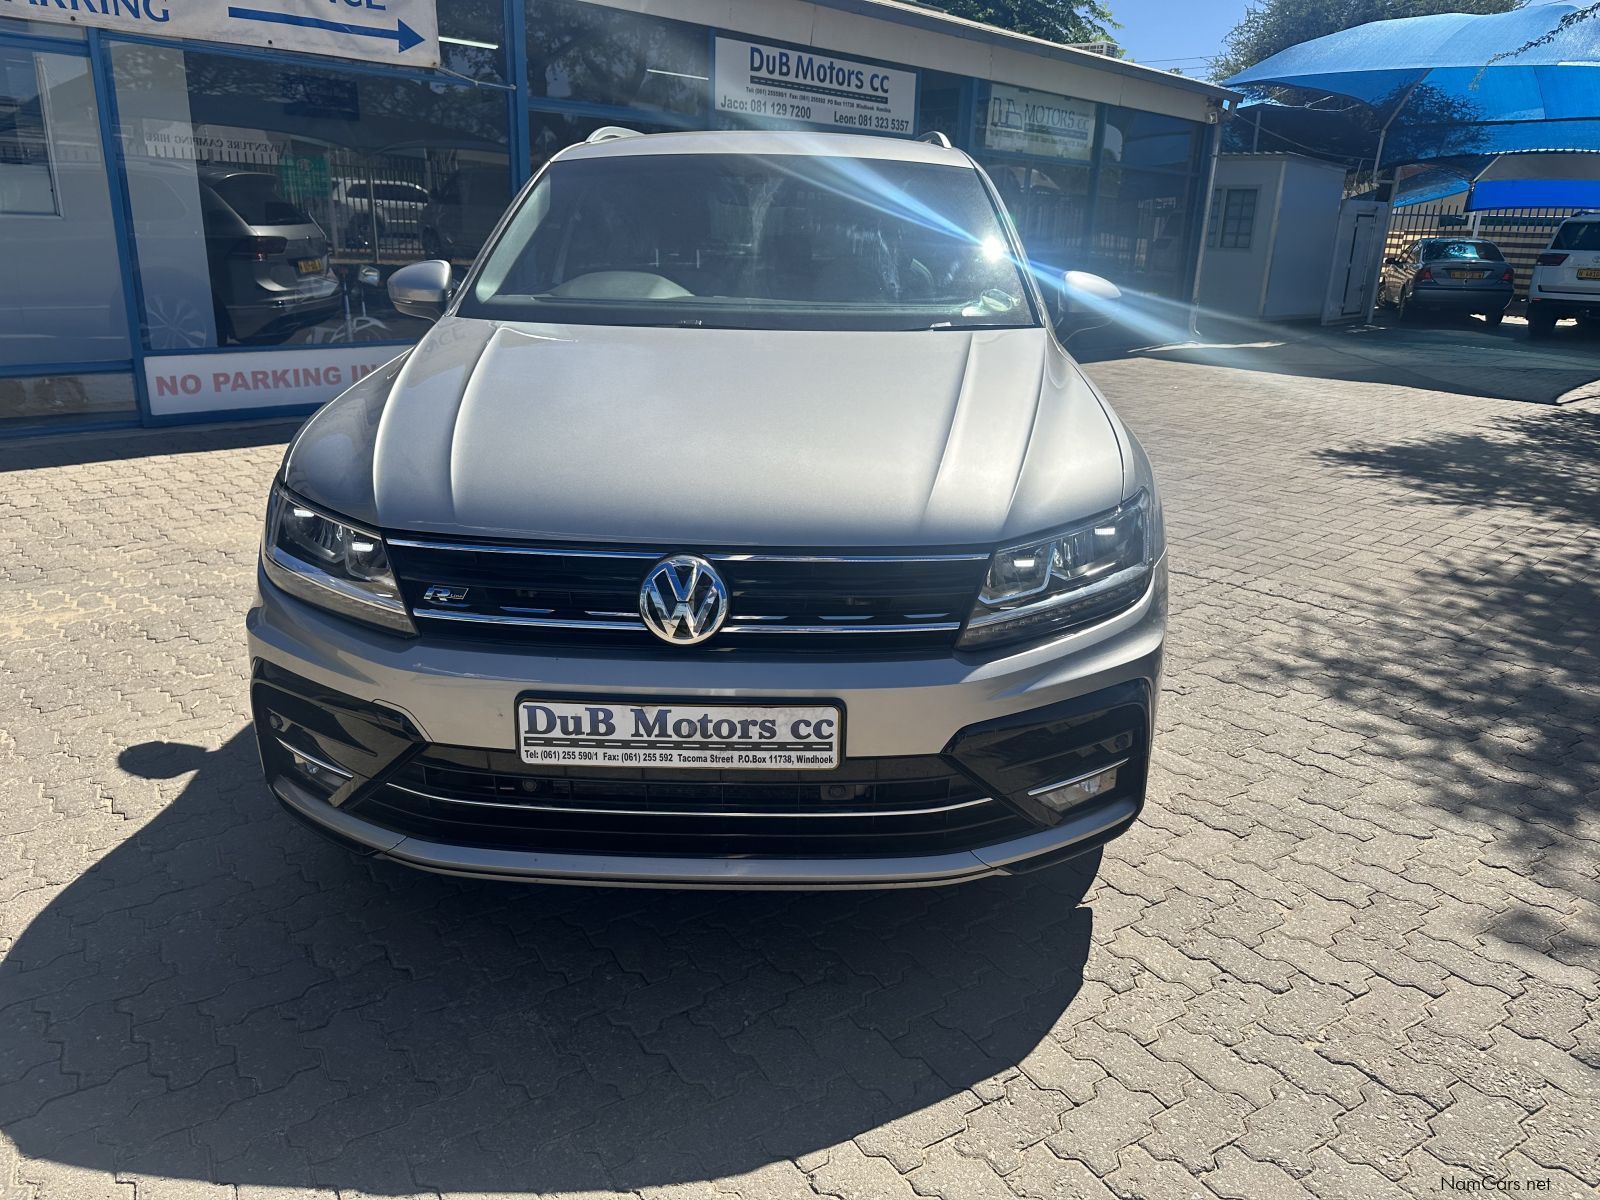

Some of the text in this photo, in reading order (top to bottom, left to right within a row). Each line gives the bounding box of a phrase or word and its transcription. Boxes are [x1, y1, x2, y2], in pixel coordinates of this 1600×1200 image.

[750, 46, 791, 77] DuB
[795, 55, 864, 89] Motors
[720, 96, 811, 120] Jaco: 081 129 7200
[1024, 103, 1075, 129] MOTORS
[834, 111, 909, 132] Leon: 081 323 5357
[155, 373, 202, 397] NO
[212, 366, 342, 393] PARKING
[523, 704, 835, 741] DuB Motors cc
[525, 749, 539, 759] Tel:
[540, 750, 560, 761] (061)
[562, 751, 576, 760] 255
[603, 752, 619, 761] Fax:
[621, 752, 641, 763] (061)
[643, 753, 657, 762] 255
[659, 753, 674, 762] 592
[677, 753, 708, 763] Tacoma
[709, 754, 734, 763] Street
[768, 755, 795, 765] 11738,
[796, 754, 833, 764] Windhoek
